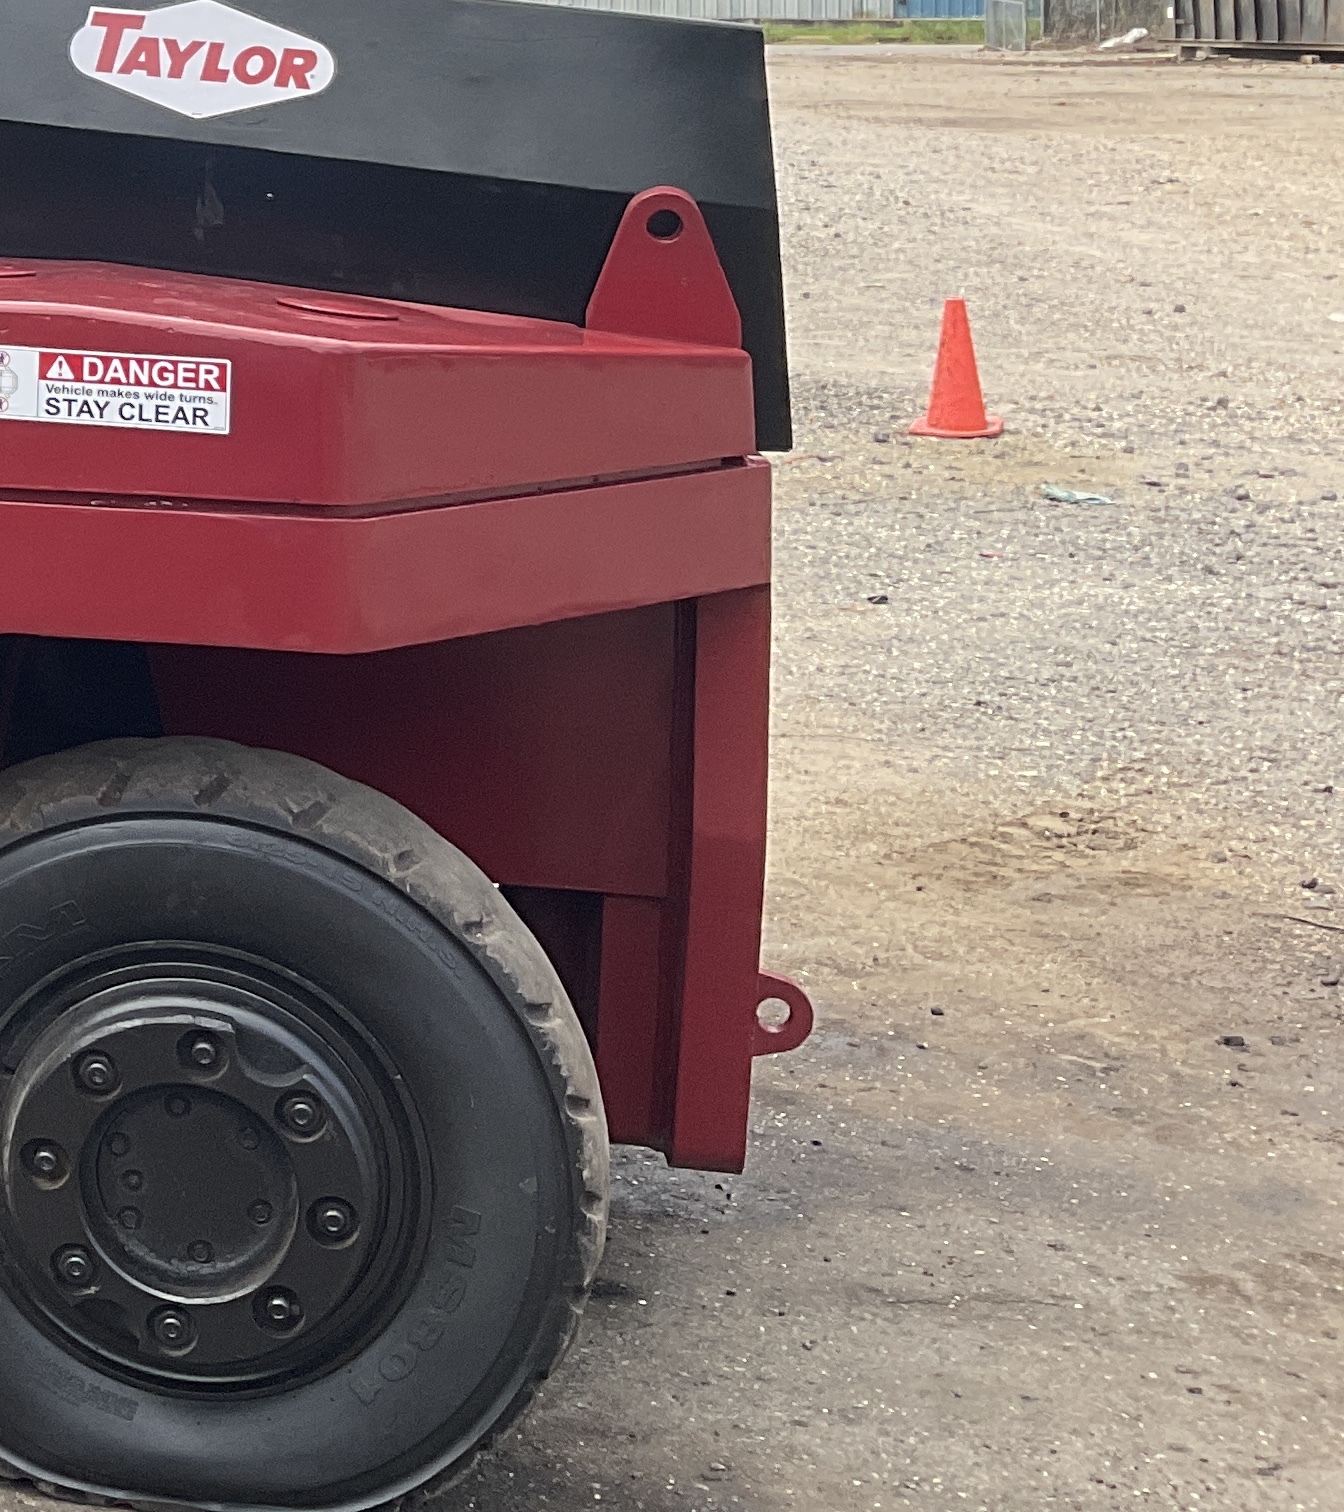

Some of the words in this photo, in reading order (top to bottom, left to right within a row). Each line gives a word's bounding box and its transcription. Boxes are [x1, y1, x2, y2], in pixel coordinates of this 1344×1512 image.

[90, 11, 318, 90] TAYLOR
[82, 356, 221, 390] DANGER
[45, 383, 93, 397] Vehicle
[97, 387, 140, 400] makes
[144, 390, 175, 402] wide
[179, 392, 218, 405] turns.
[45, 397, 110, 419] STAY
[118, 402, 210, 426] CLEAR
